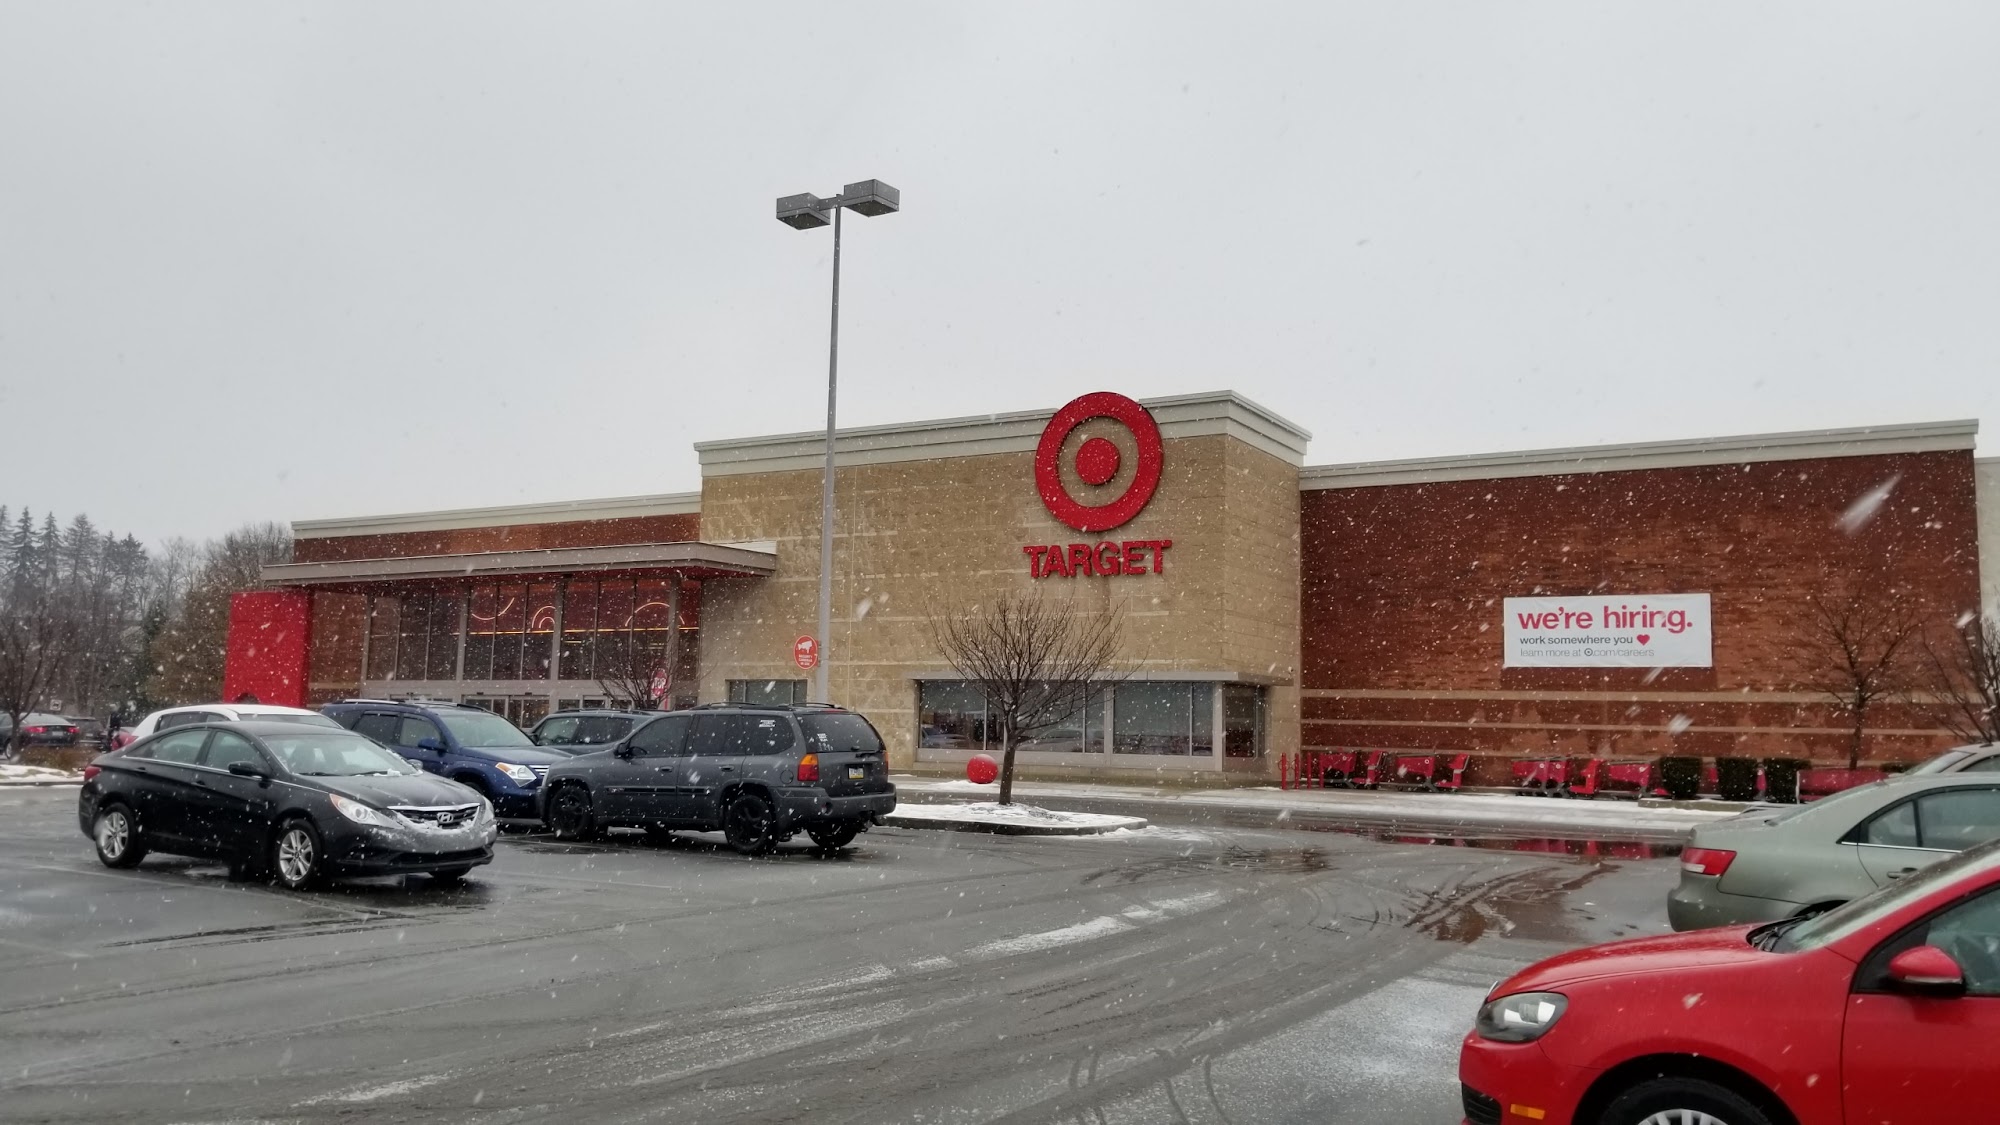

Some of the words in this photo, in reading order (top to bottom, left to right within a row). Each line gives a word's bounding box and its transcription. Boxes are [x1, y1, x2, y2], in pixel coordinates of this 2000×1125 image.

[1023, 540, 1172, 578] TARGET
[1517, 606, 1593, 629] we're
[1604, 605, 1693, 634] hiring.
[1519, 635, 1546, 645] work
[1547, 635, 1612, 645] somewhere
[1613, 636, 1633, 646] you
[1520, 648, 1544, 657] learn
[1545, 648, 1571, 657] more
[1572, 648, 1582, 657] at
